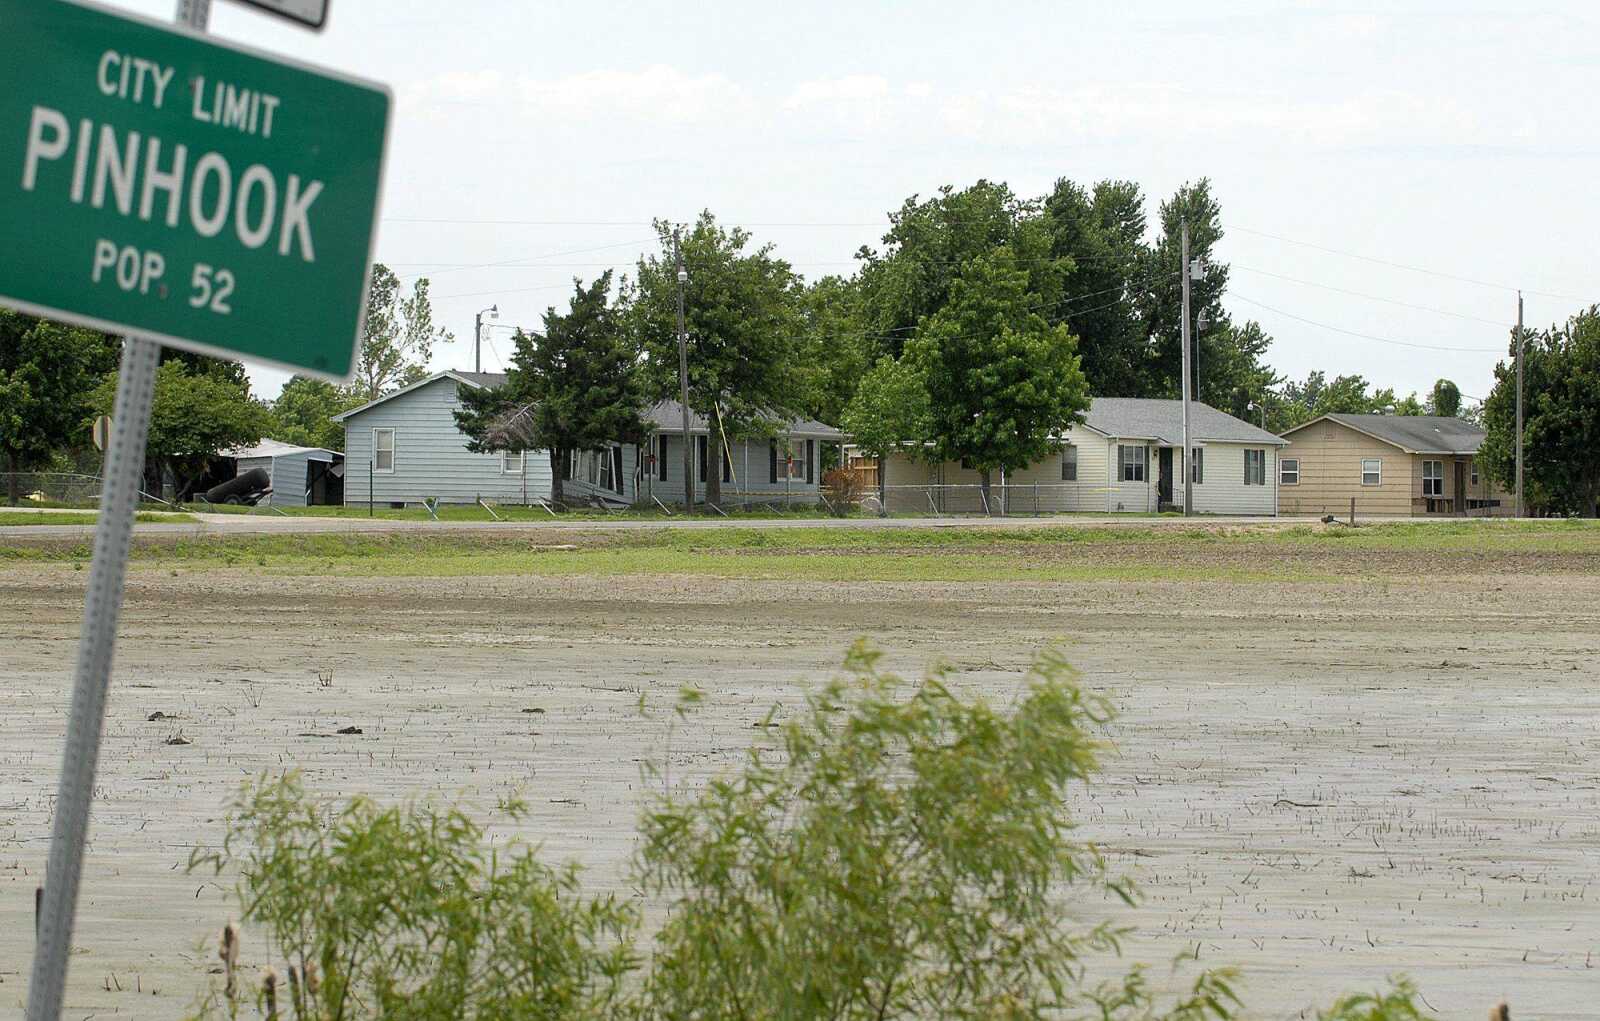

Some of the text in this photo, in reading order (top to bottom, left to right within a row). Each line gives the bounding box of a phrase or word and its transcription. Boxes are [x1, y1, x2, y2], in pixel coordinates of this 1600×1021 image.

[97, 50, 280, 138] CITY LIMIT
[21, 105, 325, 263] PINHOOK
[188, 263, 236, 315] 52
